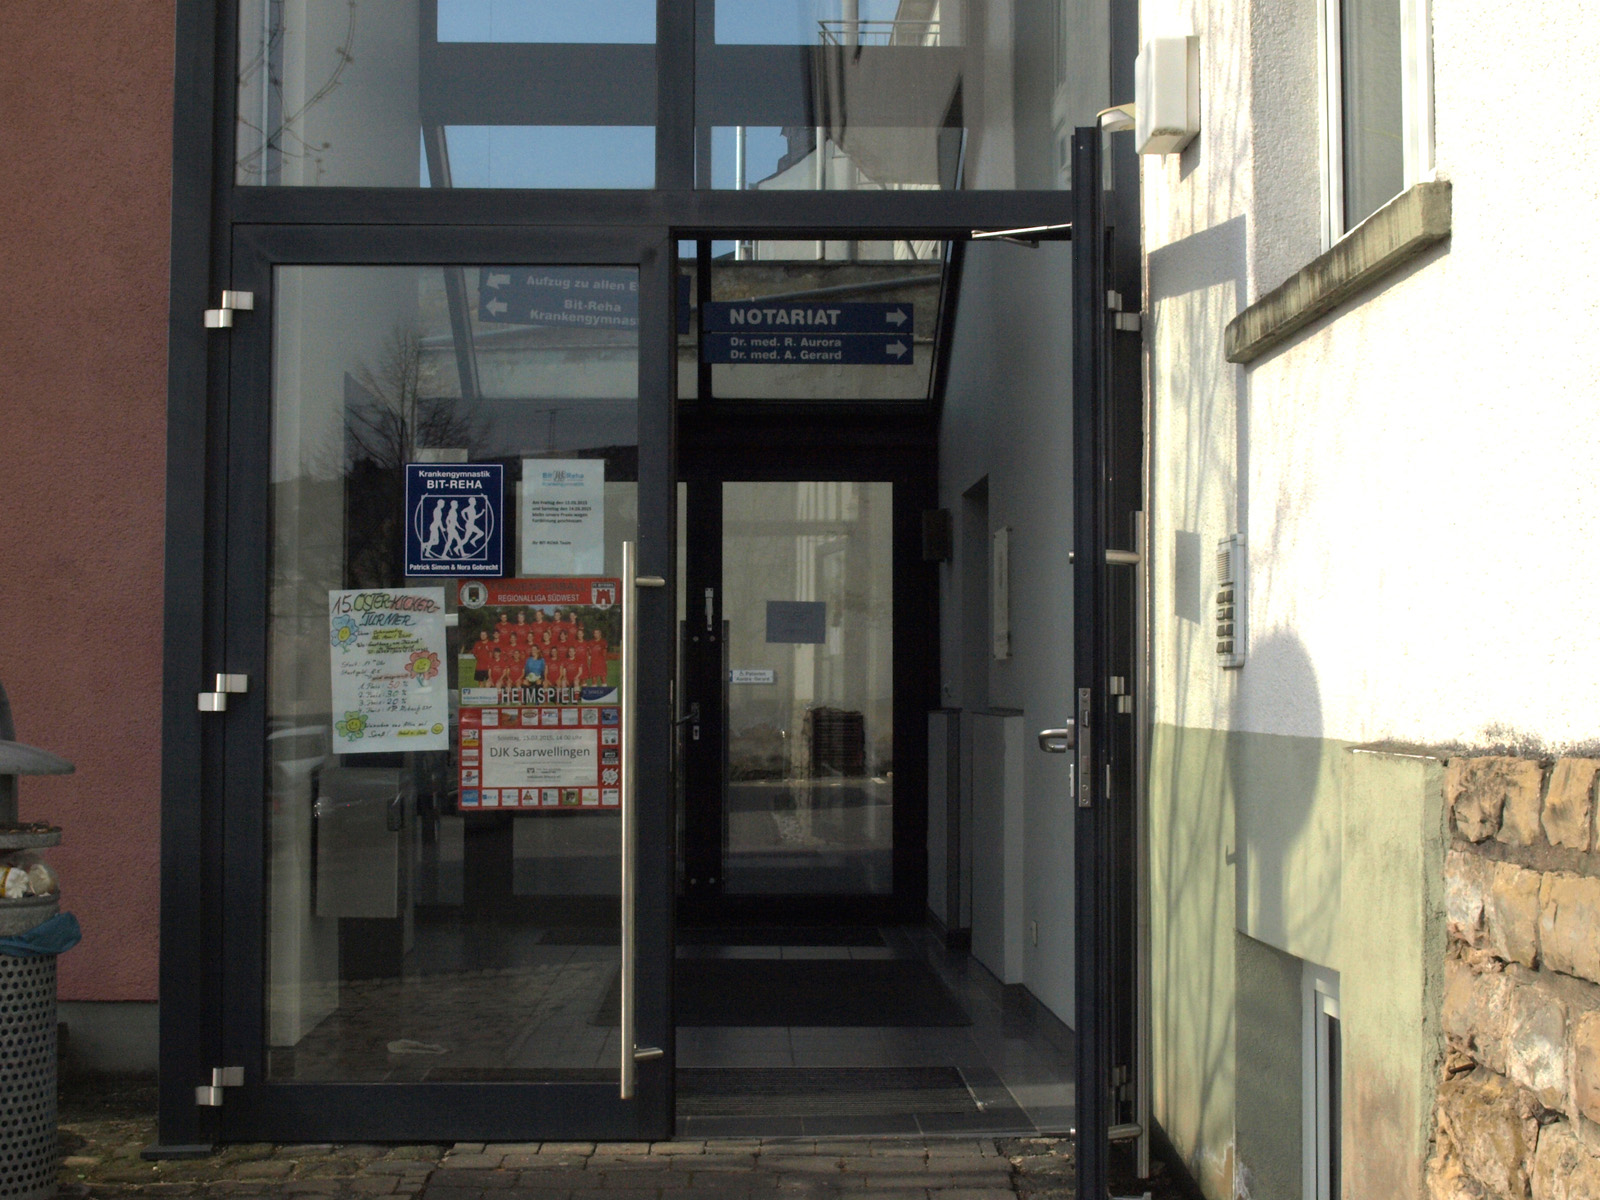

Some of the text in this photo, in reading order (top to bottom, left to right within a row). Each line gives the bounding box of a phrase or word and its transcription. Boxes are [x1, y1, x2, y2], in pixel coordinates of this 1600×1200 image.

[526, 275, 571, 290] Aufzug
[574, 279, 590, 289] zu
[593, 278, 625, 291] allen
[564, 300, 622, 313] Bit-Reha
[729, 308, 842, 326] NOTARIAT
[730, 337, 842, 348] Dr. med. R. Aurora
[730, 350, 842, 360] Dr. med. A. Gerard
[418, 470, 491, 479] Krankengymnastik
[426, 479, 483, 489] BIT-REHA
[547, 593, 580, 602] SÜDWEST
[332, 594, 353, 615] 15.
[501, 687, 578, 705] HEIMSPIEL
[489, 747, 510, 758] DJK
[512, 746, 591, 759] Saarwellingen
